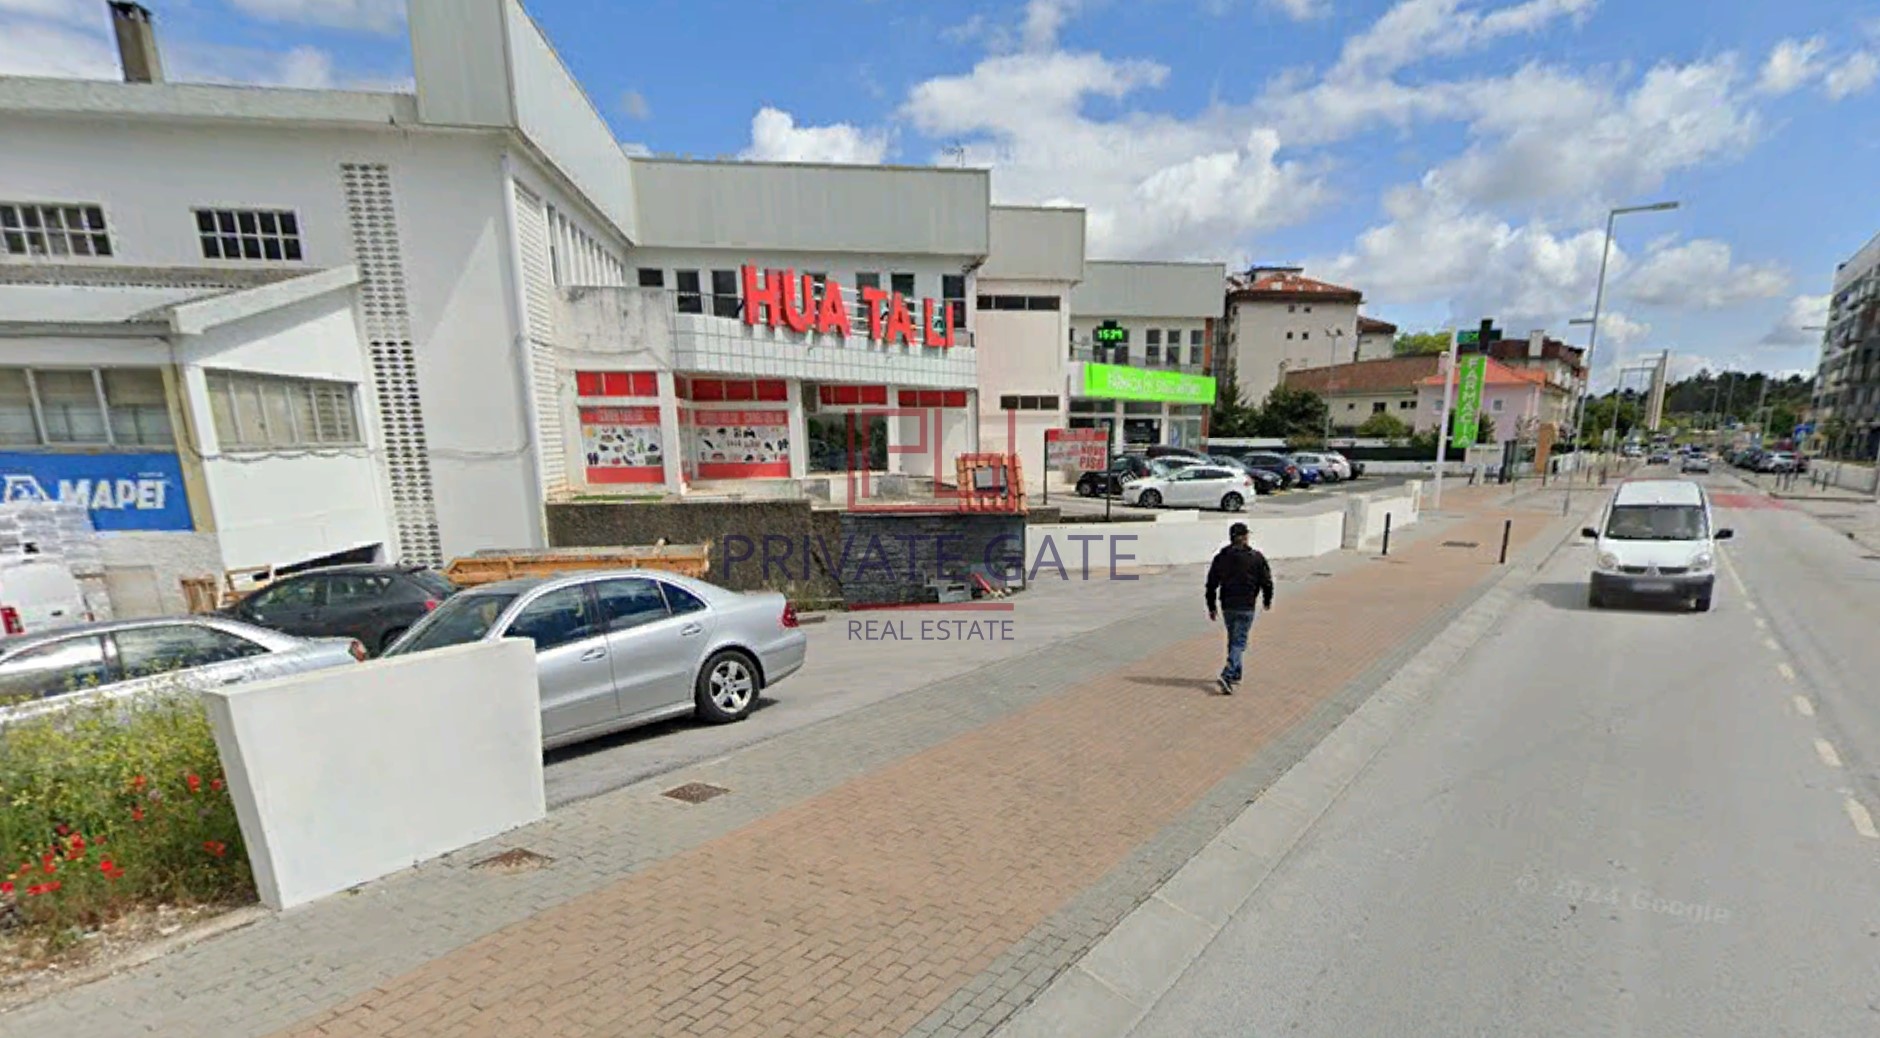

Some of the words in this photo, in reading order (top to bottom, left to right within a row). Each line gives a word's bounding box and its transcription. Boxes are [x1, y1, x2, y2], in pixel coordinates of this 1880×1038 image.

[742, 259, 851, 338] HUA
[1459, 357, 1478, 446] FARMACIA
[58, 479, 166, 510] MAPEI
